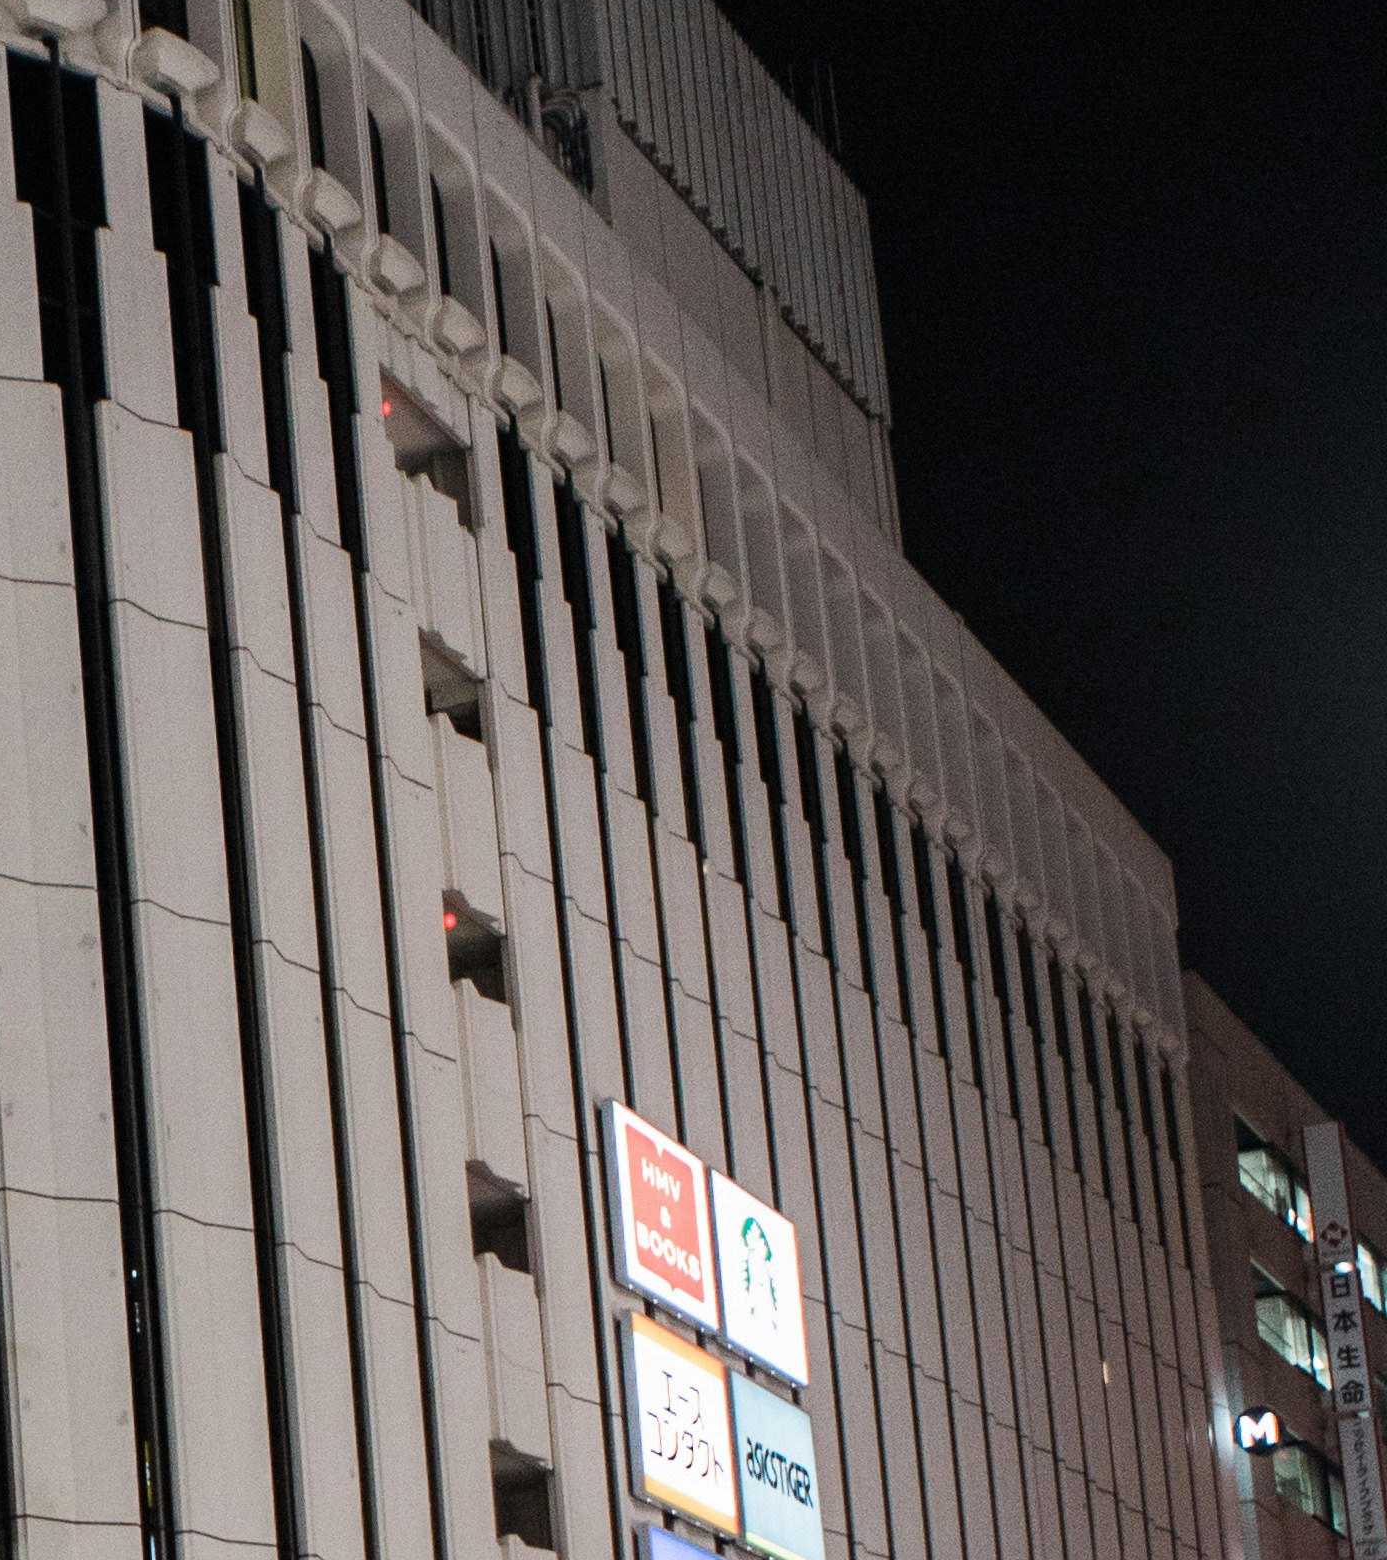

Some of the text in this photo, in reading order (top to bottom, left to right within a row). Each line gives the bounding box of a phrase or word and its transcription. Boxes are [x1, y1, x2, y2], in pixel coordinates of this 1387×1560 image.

[640, 1154, 683, 1203] HMV
[660, 1205, 673, 1230] &
[635, 1221, 702, 1282] BOOKS
[1329, 1274, 1365, 1405] 日本生命
[662, 1370, 705, 1425] エース
[647, 1412, 725, 1487] コンタクト
